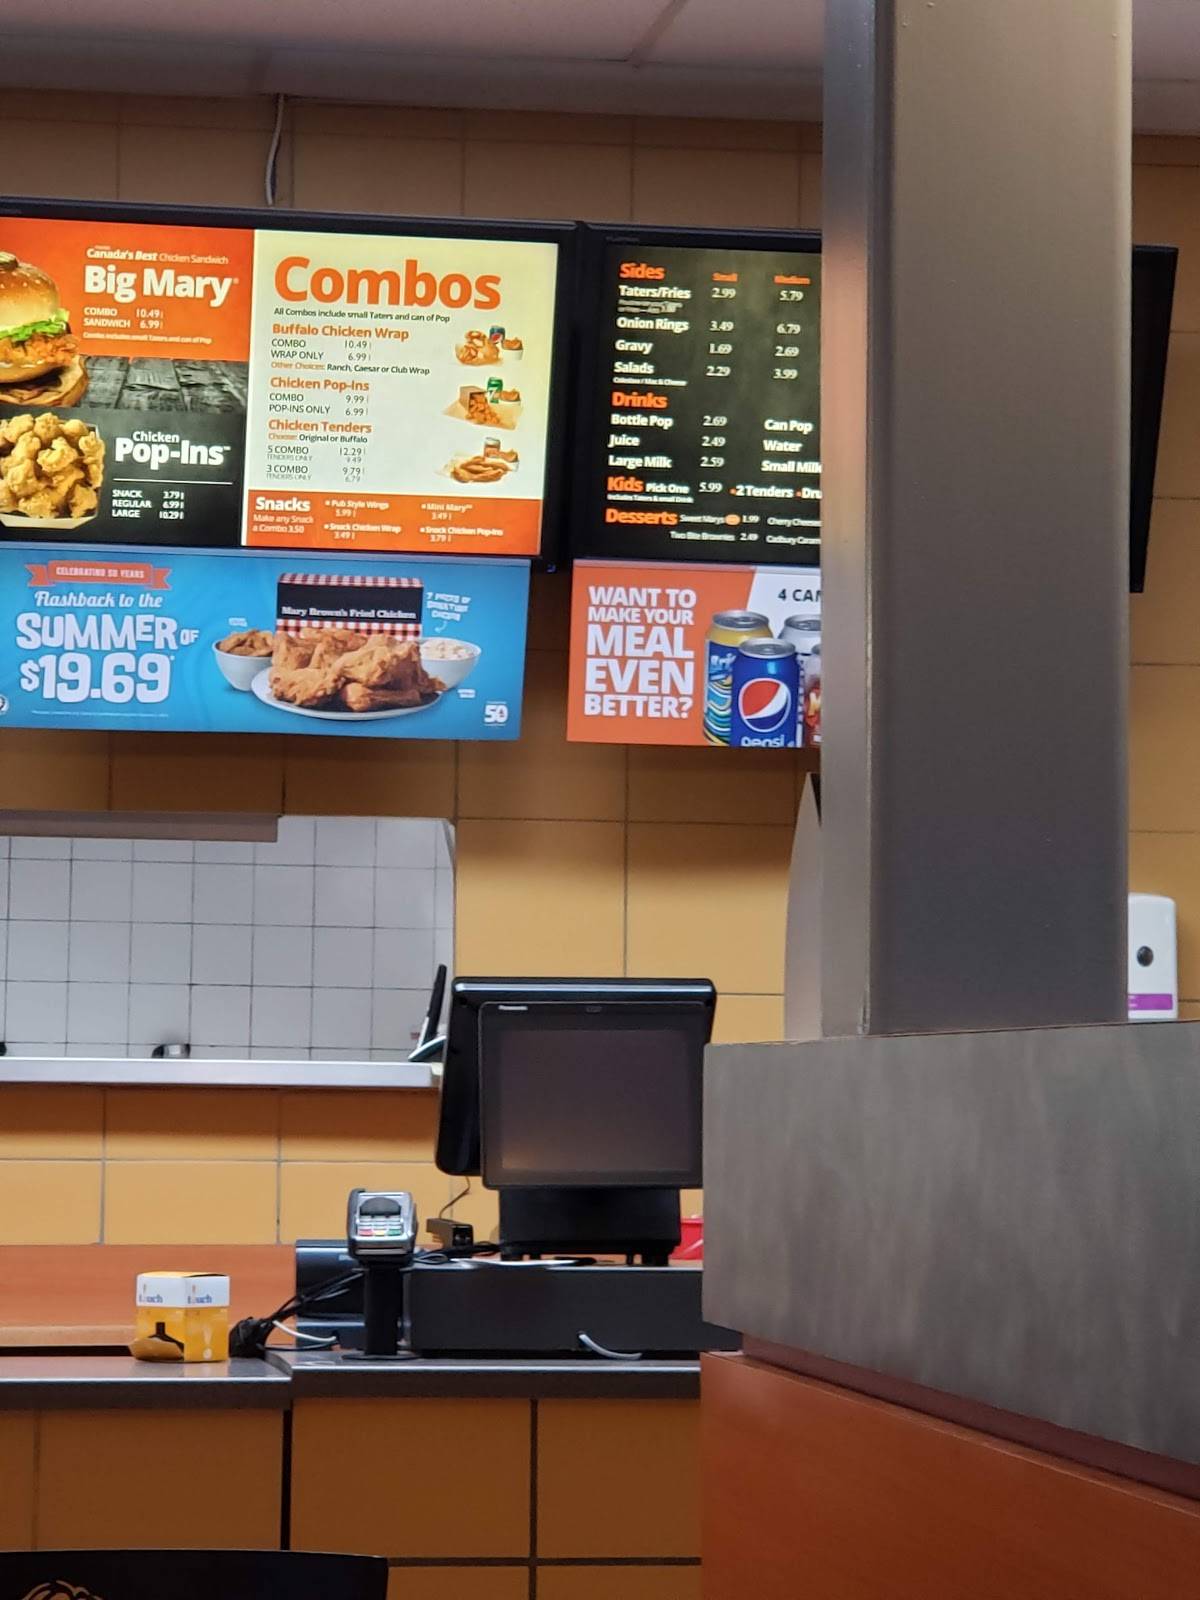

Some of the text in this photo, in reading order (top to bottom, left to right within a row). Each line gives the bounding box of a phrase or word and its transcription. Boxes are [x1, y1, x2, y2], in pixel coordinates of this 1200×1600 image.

[86, 248, 133, 260] Canada's
[135, 250, 158, 261] Best
[191, 255, 229, 265] Sandwich
[619, 263, 665, 280] Sides
[84, 264, 232, 308] Big Mary
[274, 256, 502, 310] Combos
[618, 285, 803, 301] Taters/Fries 2.99 5.79
[84, 307, 160, 318] COMBO 10.49
[285, 308, 316, 317] Combos
[318, 309, 346, 318] include
[347, 310, 367, 319] small
[369, 312, 393, 320] Taters
[395, 312, 409, 321] and
[426, 313, 434, 322] of
[436, 314, 450, 324] Pop
[83, 318, 160, 329] SANDWICH 6.99
[616, 317, 800, 334] Onion Rings 3.49 6.79
[272, 324, 409, 341] Buffalo Chicken Wrap
[271, 338, 367, 349] COMBO 10.49
[615, 340, 653, 355] Gravy
[271, 350, 367, 361] WRAP ONLY 6.99
[327, 363, 352, 373] Ranch,
[354, 364, 380, 373] Caesar
[391, 366, 408, 374] Club
[409, 366, 430, 375] Wrap
[613, 361, 654, 374] Salads
[773, 368, 798, 379] 3.99
[270, 377, 370, 393] Chicken Pop-Ins
[269, 393, 364, 404] COMBO 9.99
[612, 392, 668, 409] Drinks
[269, 404, 364, 416] POP-INS ONLY 6.99
[268, 419, 372, 433] Chicken Tenders
[611, 414, 648, 426] Bottle
[649, 415, 673, 430] Pop
[764, 419, 788, 431] Can
[789, 420, 813, 434] Pop
[133, 431, 180, 443] Chicken
[299, 433, 329, 443] Original
[340, 435, 368, 443] Buffalo
[607, 434, 802, 452] Juice 2.49 Water
[115, 437, 224, 470] Pop-Ins
[268, 445, 362, 456] 5 COMBO 12.29
[266, 464, 360, 475] 3 COMBO 9.79
[608, 455, 642, 469] Large
[644, 456, 672, 468] Milk
[700, 457, 724, 467] 2.59
[761, 460, 795, 472] Small
[112, 489, 142, 498] SNACK
[607, 476, 644, 492] Kids
[645, 482, 666, 493] Pick
[667, 483, 690, 494] One
[747, 484, 794, 498] Tenders
[112, 499, 152, 508] REGULAR
[255, 496, 311, 512] Snacks
[112, 509, 140, 518] LARGE
[605, 507, 678, 525] Desserts
[120, 569, 144, 579] YEARS
[35, 590, 163, 608] Flashback to the
[588, 585, 696, 608] WANT TO
[778, 588, 787, 601] 4
[281, 606, 416, 619] Mary Brown's Fried Chicken
[588, 607, 694, 626] MAKE YOUR
[16, 611, 200, 651] SUMMER OF
[587, 624, 695, 659] MEAL
[585, 657, 695, 695] EVEN
[584, 693, 694, 719] BETTER?
